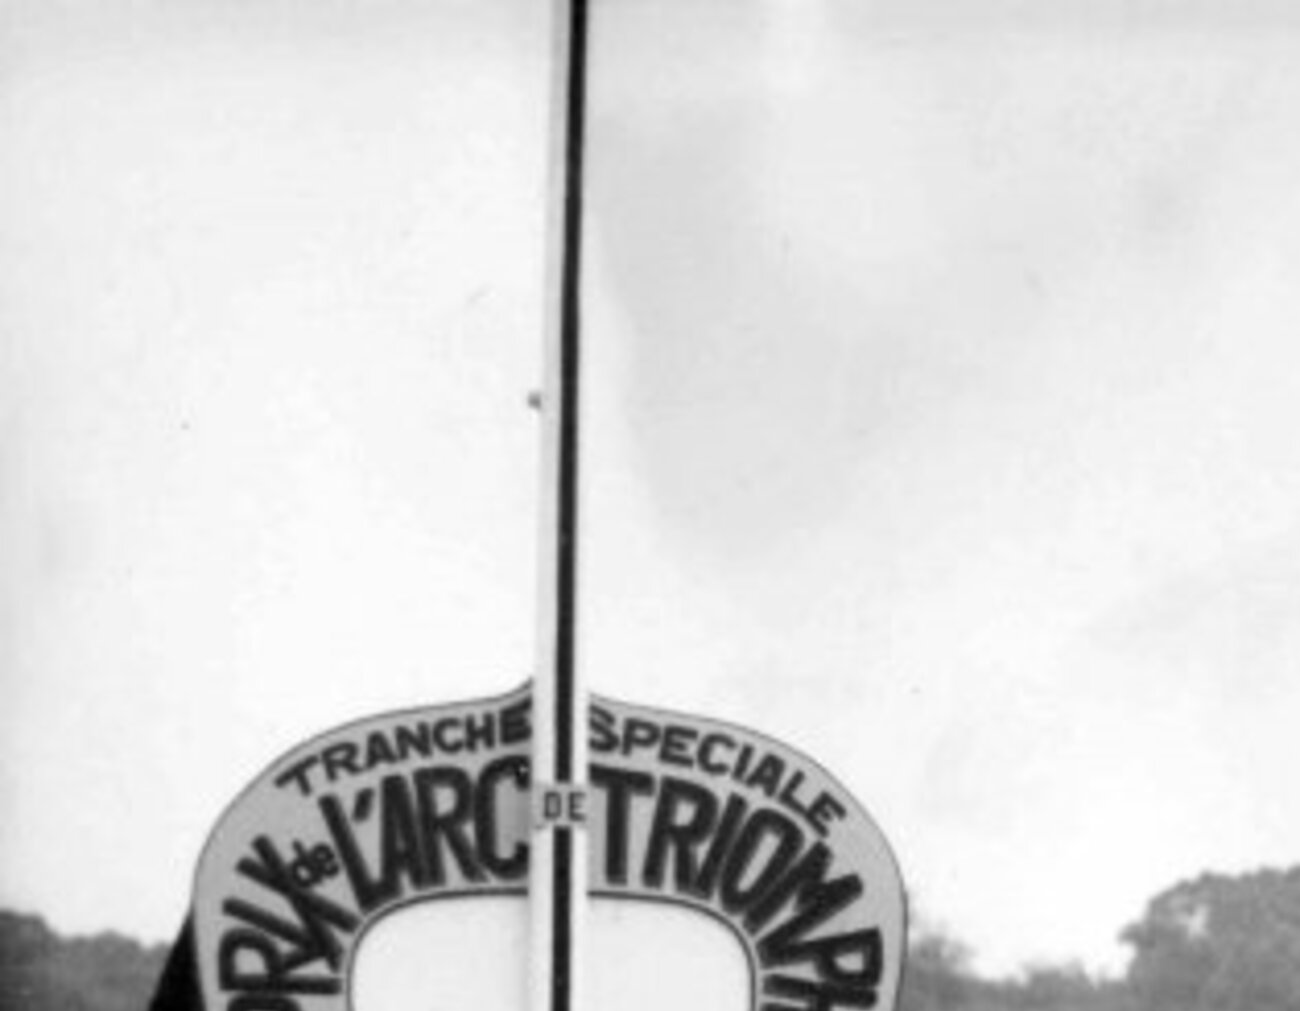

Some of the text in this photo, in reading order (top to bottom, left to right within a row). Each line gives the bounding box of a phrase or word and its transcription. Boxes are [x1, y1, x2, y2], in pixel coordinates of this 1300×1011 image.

[274, 702, 847, 838] TRANCHE SPECIALE
[289, 839, 340, 888] de
[317, 754, 532, 910] L'ARC
[543, 791, 587, 821] DE
